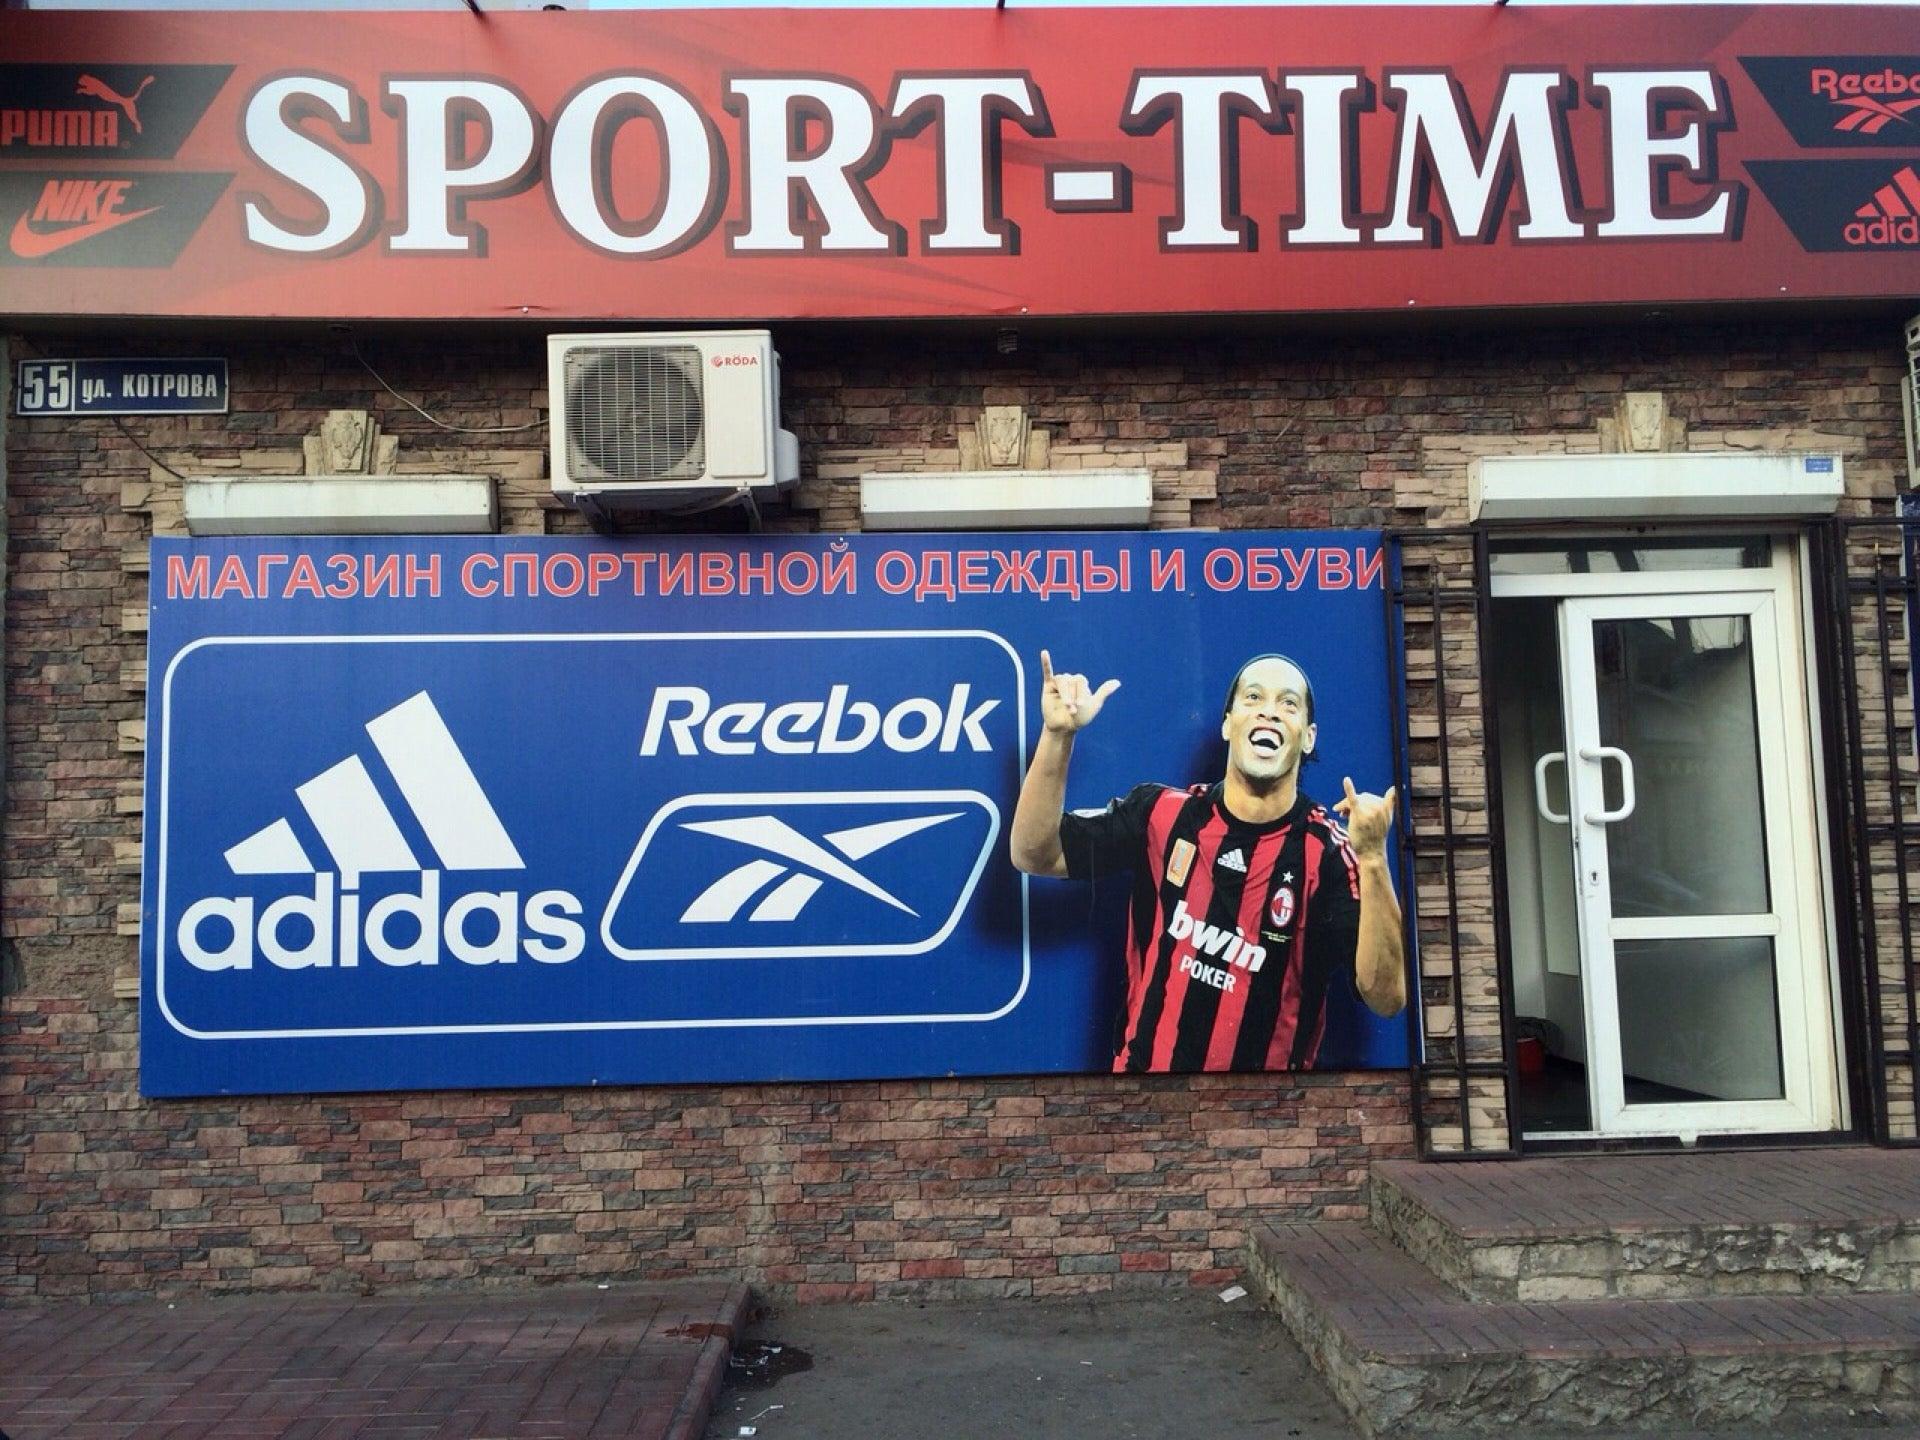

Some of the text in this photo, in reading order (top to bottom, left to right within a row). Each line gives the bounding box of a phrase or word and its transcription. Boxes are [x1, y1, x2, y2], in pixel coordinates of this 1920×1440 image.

[1, 110, 118, 147] PUMA
[244, 71, 1731, 254] SPORT-TIME
[31, 179, 134, 222] NIKE
[23, 365, 218, 409] 55 ул. КОТРОВА
[166, 541, 1385, 602] МАГАЗИН СПОРТИВНОЙ ОДЕЖДЫ И ОБУВИ
[639, 683, 1002, 757] Reebok
[177, 869, 587, 972] adidas
[1167, 899, 1268, 973] bwin
[1179, 955, 1237, 993] POKER
